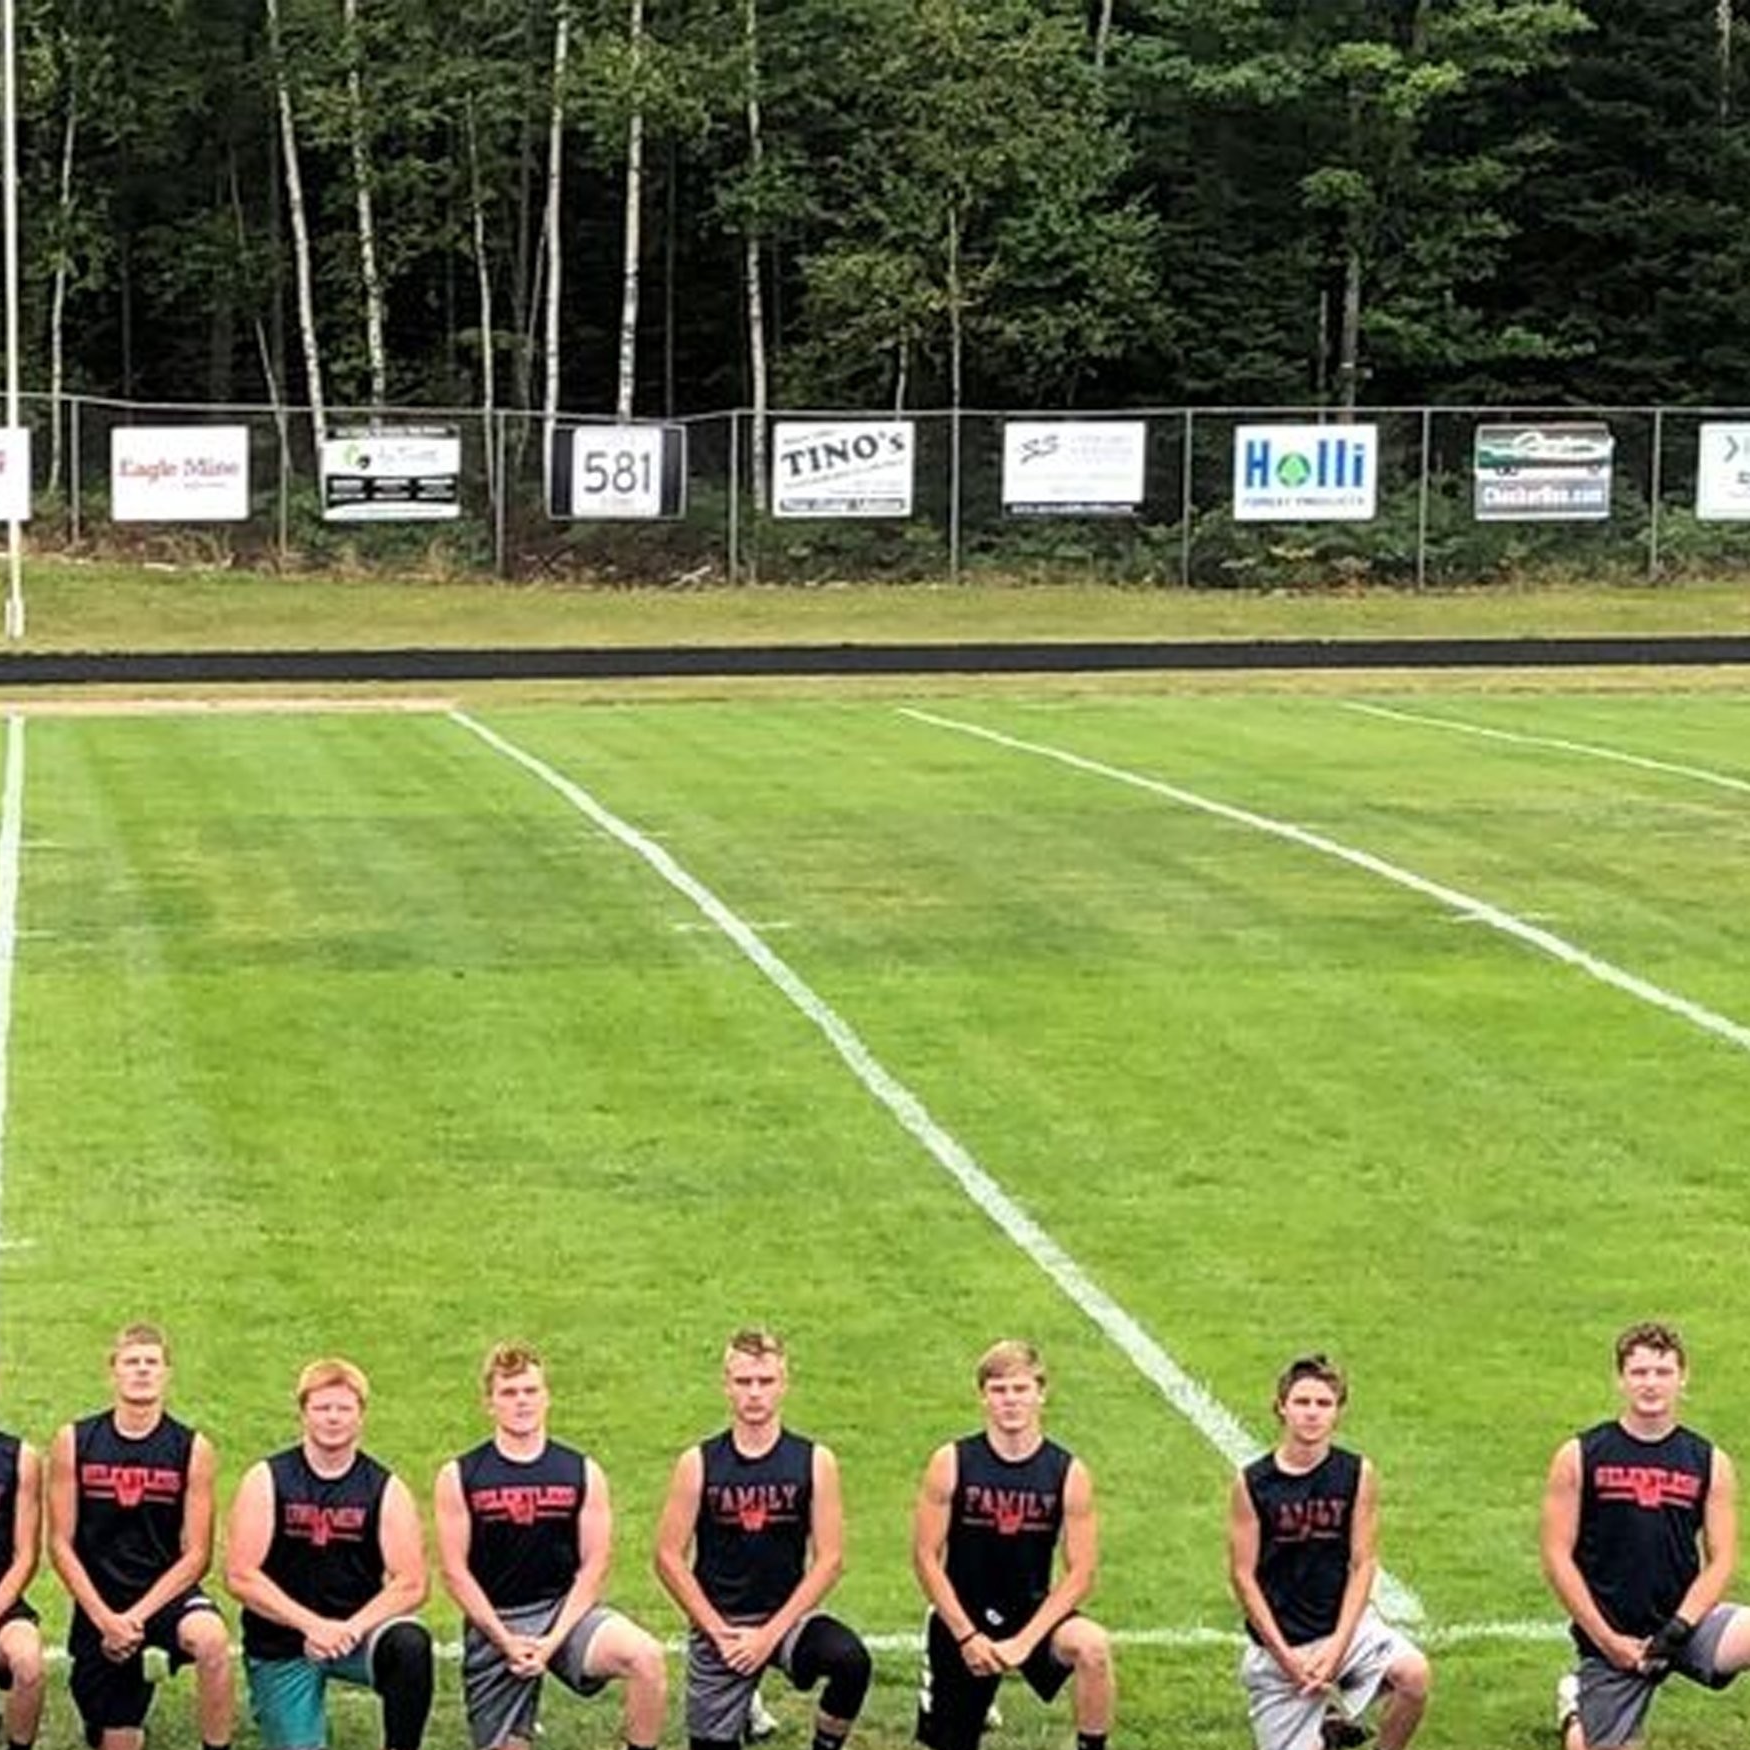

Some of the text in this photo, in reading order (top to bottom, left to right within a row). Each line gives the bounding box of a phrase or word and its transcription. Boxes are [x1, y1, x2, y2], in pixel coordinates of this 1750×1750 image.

[118, 458, 239, 482] Eagle Mine
[583, 451, 652, 494] 581
[1245, 438, 1365, 489] Holli
[707, 1484, 798, 1513] FAMILY
[964, 1485, 1057, 1518] FAMILY
